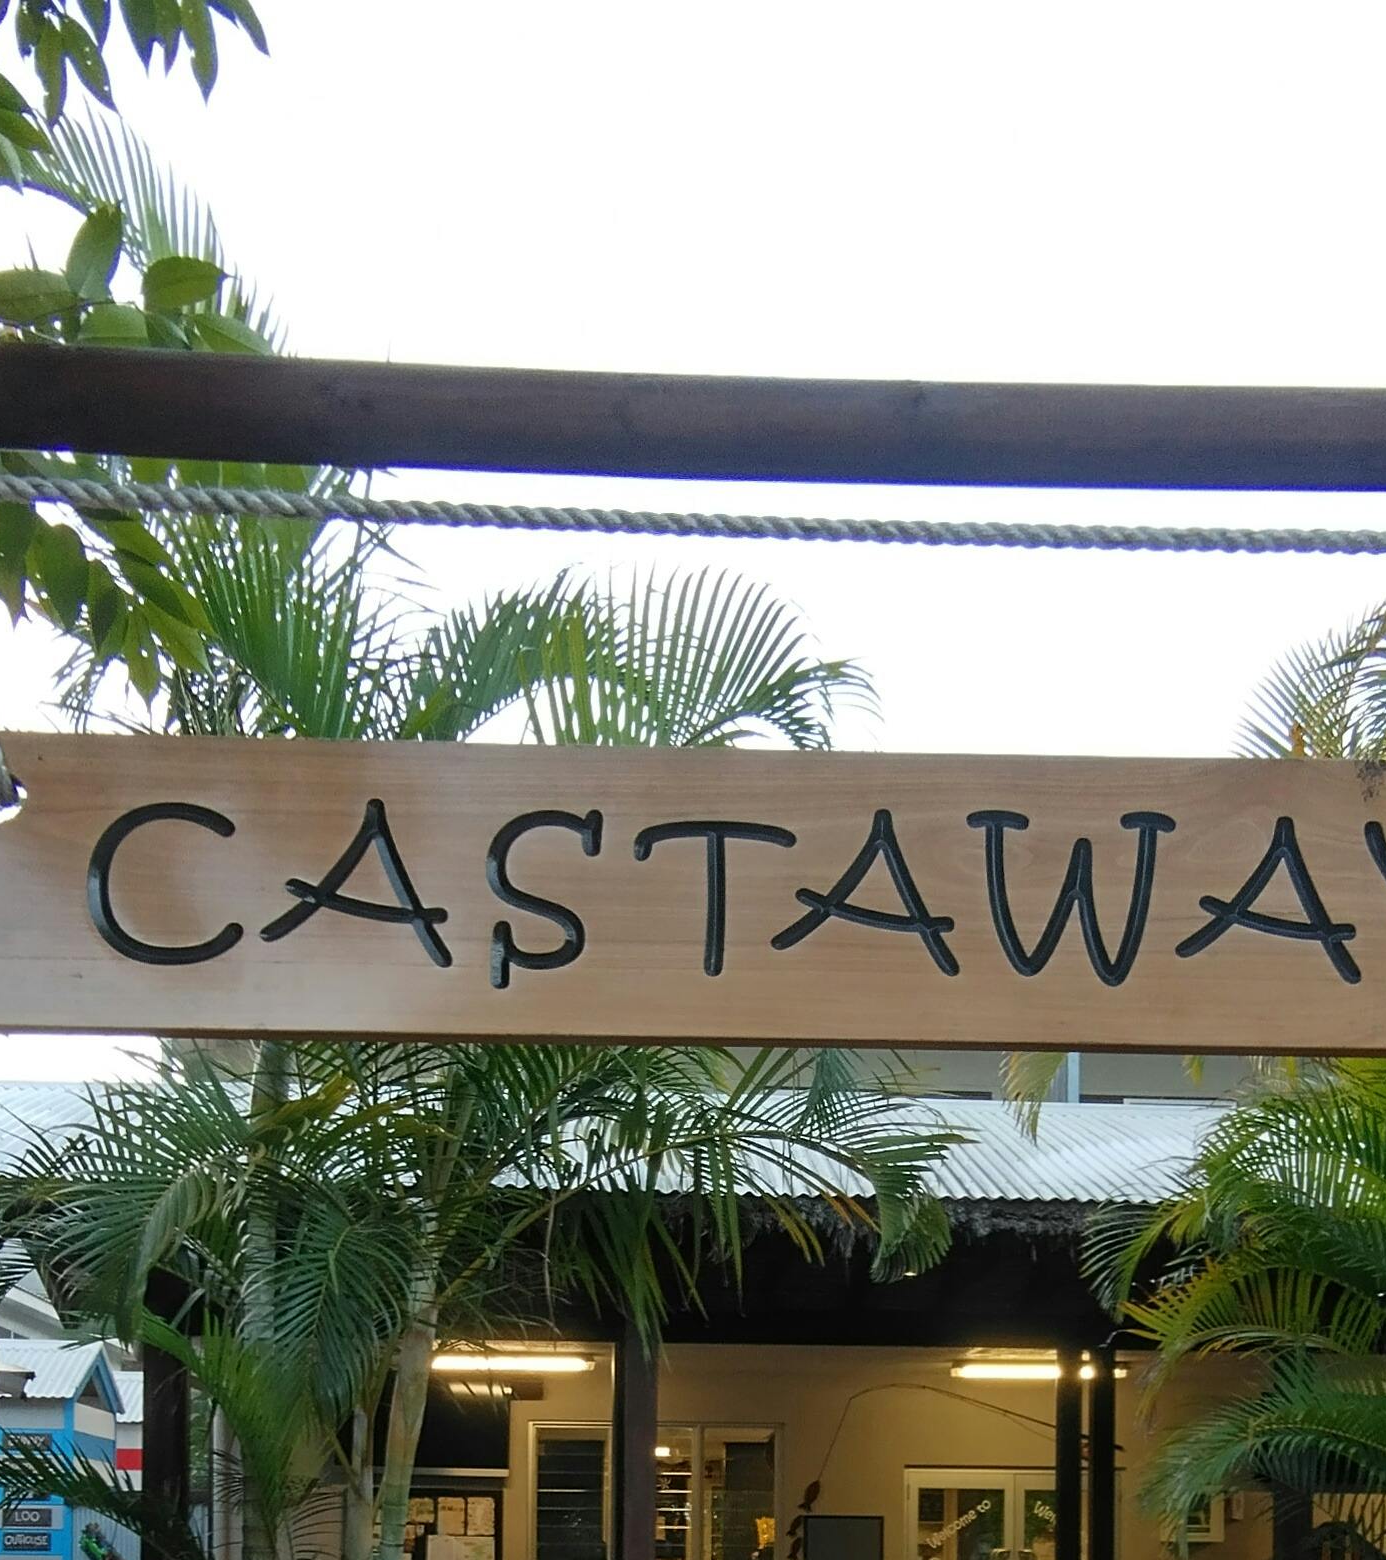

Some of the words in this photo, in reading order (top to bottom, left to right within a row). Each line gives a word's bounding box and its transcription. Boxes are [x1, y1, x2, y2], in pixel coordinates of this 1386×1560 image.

[14, 1511, 40, 1523] LOO
[925, 1508, 977, 1549] Welcome
[977, 1499, 992, 1514] to
[4, 1534, 49, 1546] OUTHOUSE
